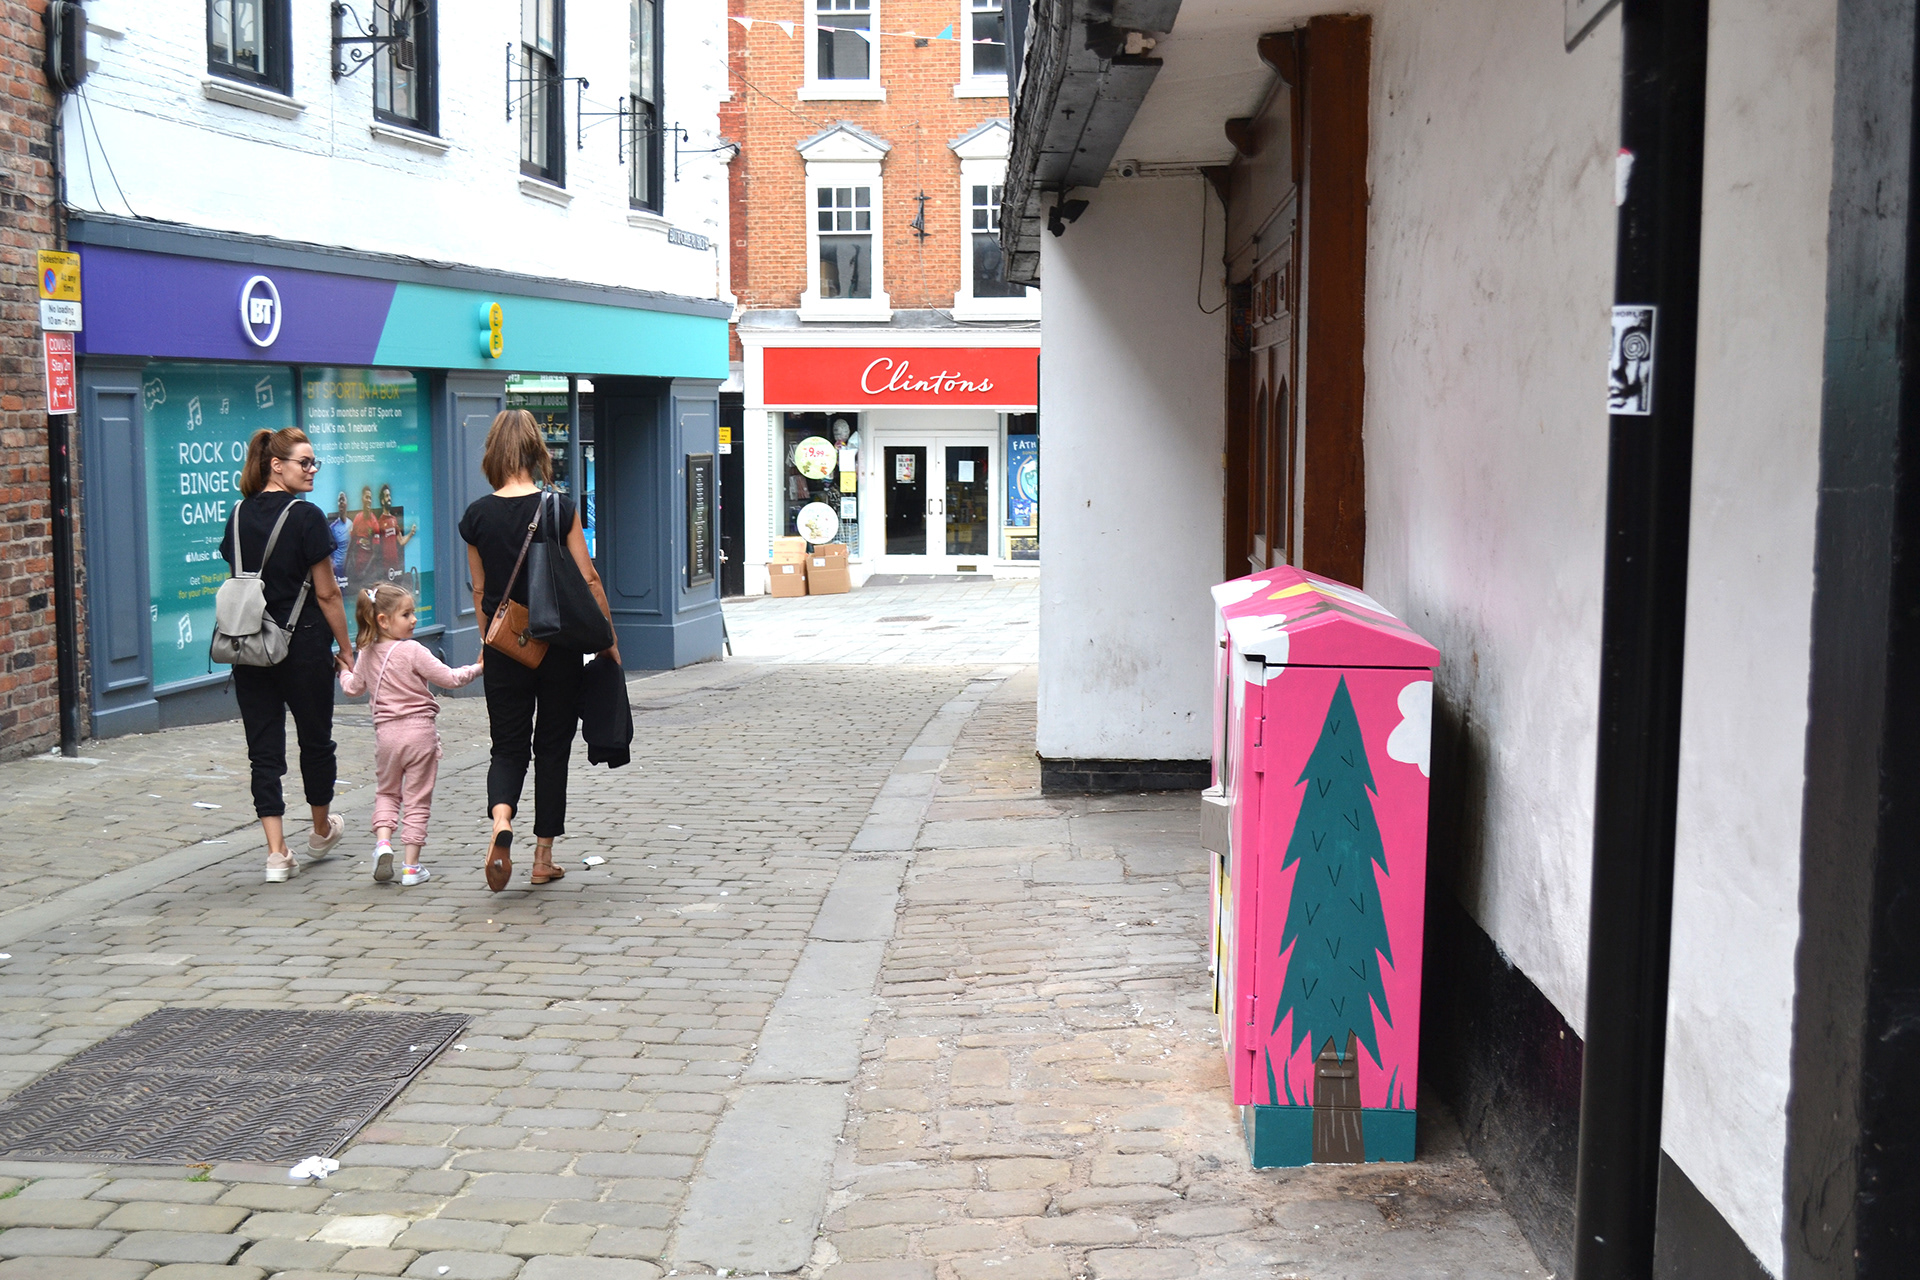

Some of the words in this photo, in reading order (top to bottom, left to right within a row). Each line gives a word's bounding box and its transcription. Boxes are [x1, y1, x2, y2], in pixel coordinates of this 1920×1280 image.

[40, 254, 65, 264] Pedestrian
[67, 257, 78, 266] Zone
[68, 275, 76, 283] any
[49, 304, 56, 313] No
[57, 306, 74, 316] loading
[250, 297, 273, 324] BT
[52, 358, 63, 374] Stay
[56, 376, 69, 387] apart
[861, 357, 994, 394] Clintons
[307, 382, 320, 399] BT
[323, 382, 357, 399] SPORT
[359, 382, 370, 399] IN
[371, 384, 379, 399] A
[381, 384, 400, 400] BOX
[309, 407, 330, 418] Unbox
[331, 408, 335, 417] 3
[336, 407, 359, 417] months
[360, 407, 367, 417] of
[368, 407, 376, 417] BT
[378, 407, 393, 419] Sport
[309, 424, 320, 433] the
[321, 424, 336, 433] UK's
[353, 422, 378, 432] network
[1013, 440, 1036, 451] FATH
[179, 441, 223, 464] ROCK
[808, 447, 824, 457] 9.99
[326, 455, 344, 465] Google
[180, 471, 229, 495] BINGE
[182, 501, 226, 525] GAME
[190, 550, 210, 562] Music
[190, 577, 200, 585] Get
[201, 575, 212, 584] The
[179, 590, 187, 599] for
[188, 590, 201, 600] your
